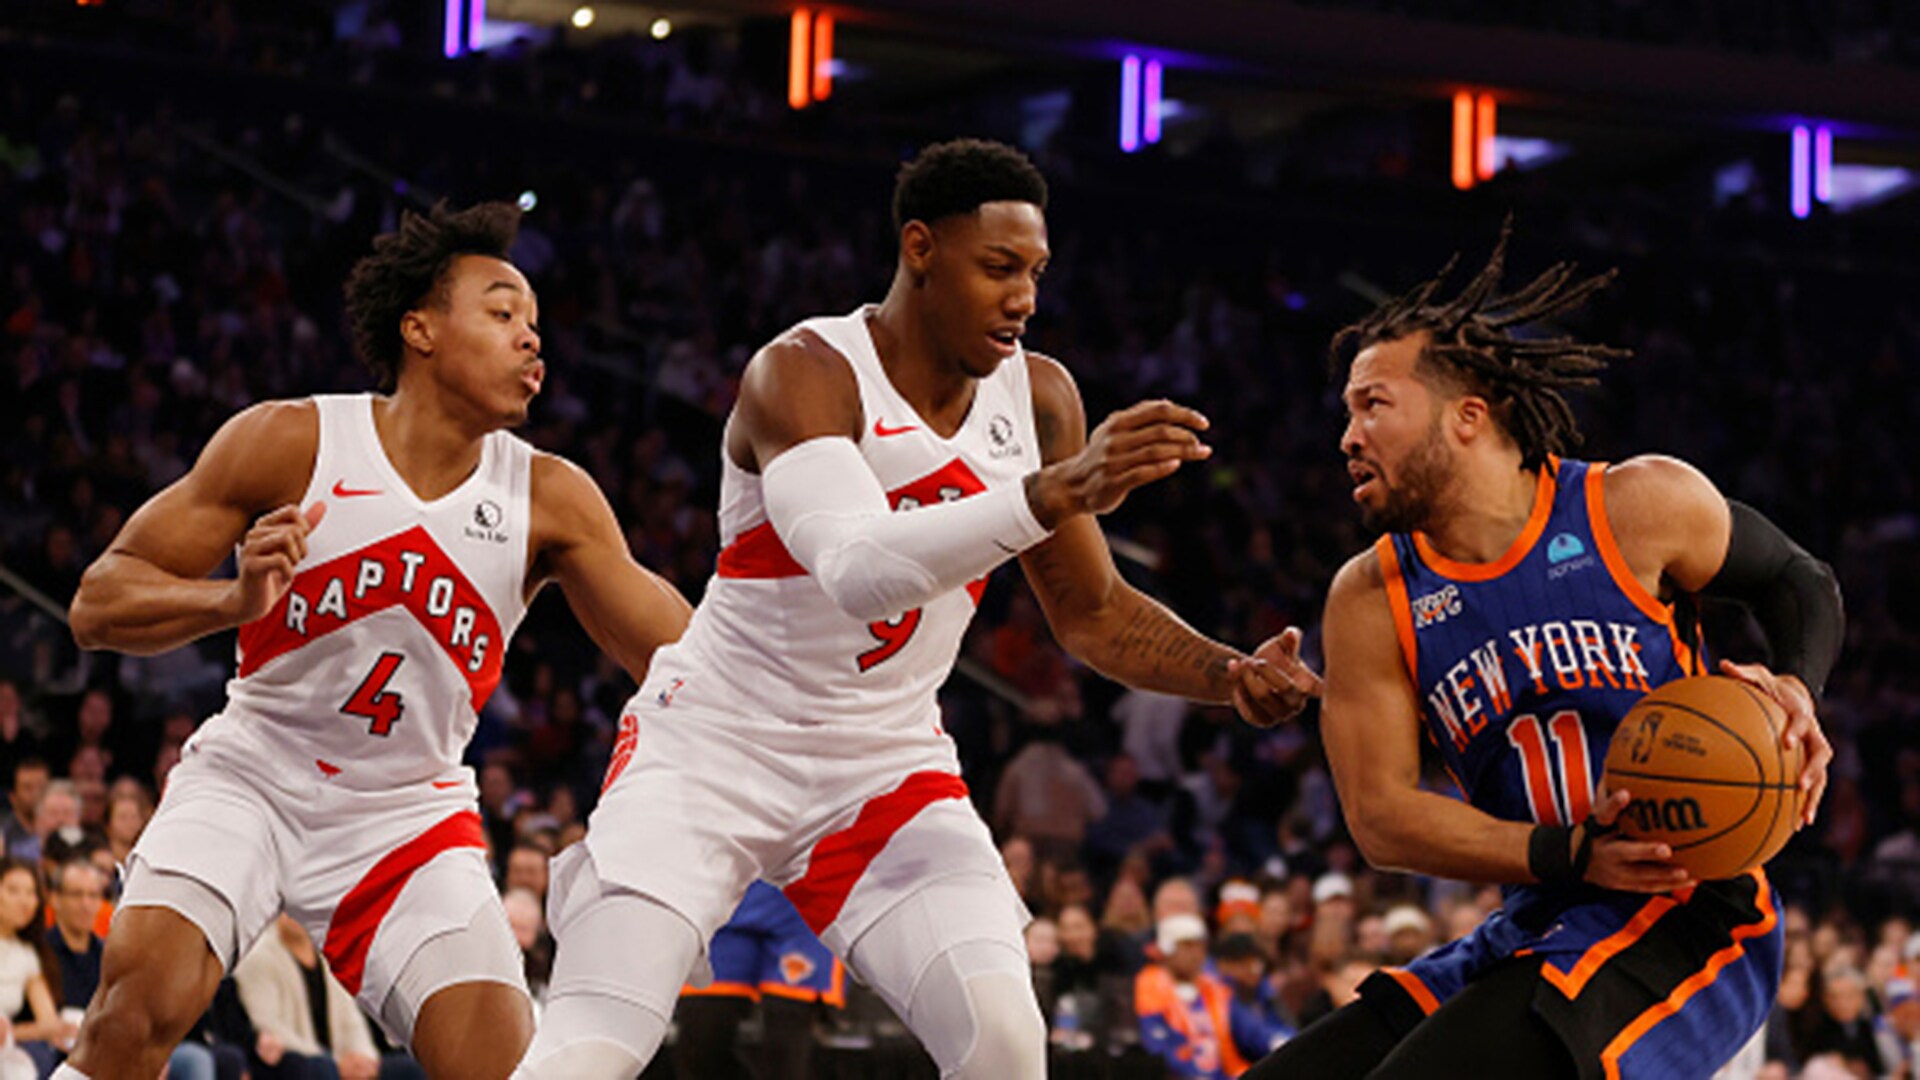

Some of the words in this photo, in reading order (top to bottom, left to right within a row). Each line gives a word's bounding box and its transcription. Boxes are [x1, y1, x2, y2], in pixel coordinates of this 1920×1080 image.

[285, 550, 489, 673] RAPTORS
[339, 650, 404, 737] 4
[1427, 639, 1513, 754] NEW
[1508, 619, 1652, 695] YORK
[1506, 709, 1597, 828] 11
